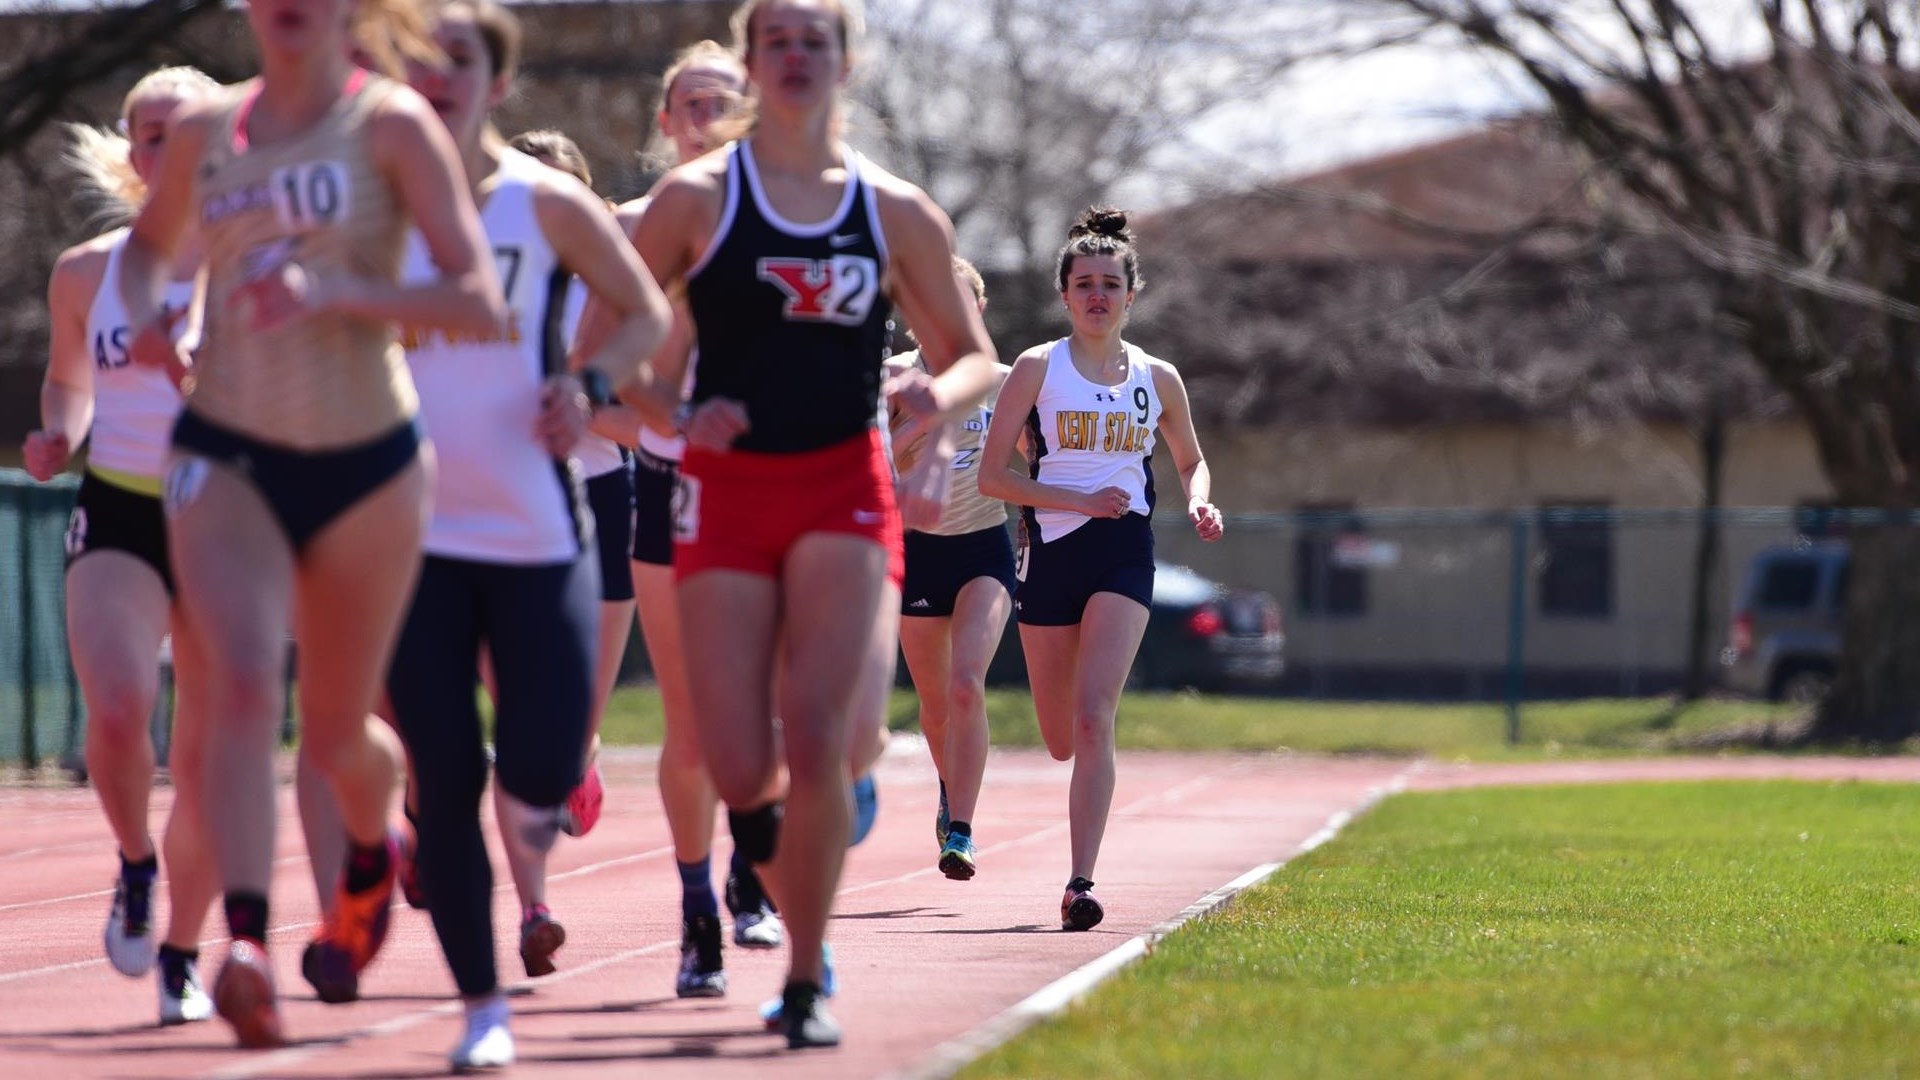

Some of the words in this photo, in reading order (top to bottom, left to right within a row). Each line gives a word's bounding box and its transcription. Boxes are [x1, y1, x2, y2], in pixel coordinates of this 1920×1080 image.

[284, 164, 338, 222] 10
[836, 264, 865, 316] 2
[96, 326, 131, 369] AS
[1133, 386, 1149, 425] 9
[1056, 411, 1099, 451] KENT
